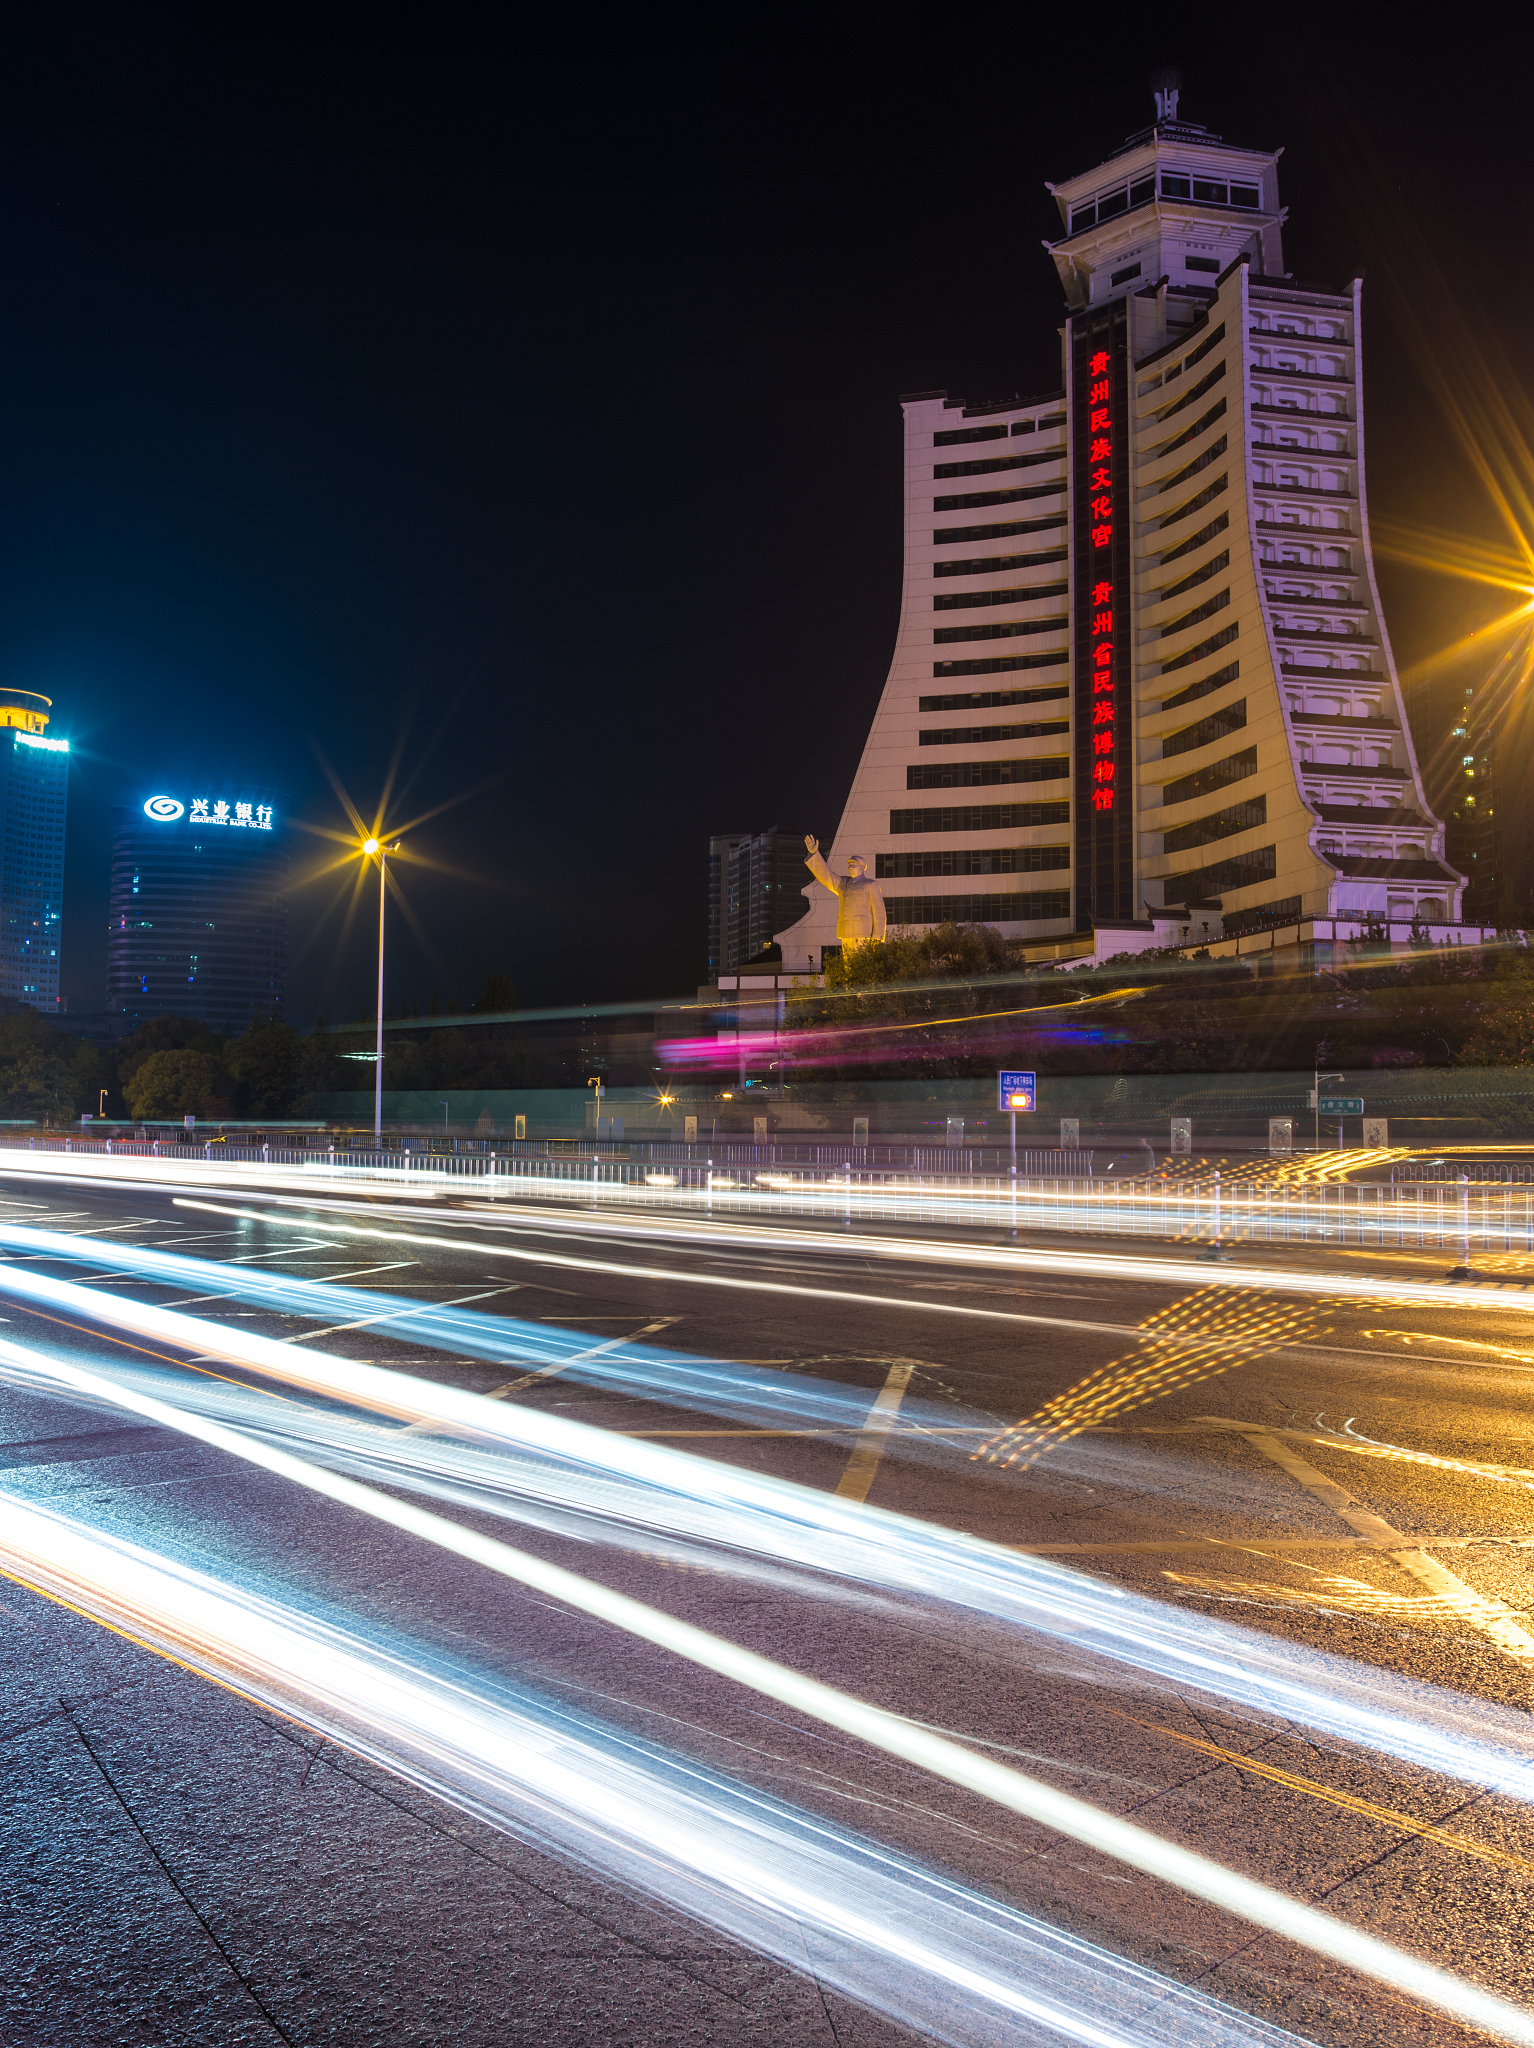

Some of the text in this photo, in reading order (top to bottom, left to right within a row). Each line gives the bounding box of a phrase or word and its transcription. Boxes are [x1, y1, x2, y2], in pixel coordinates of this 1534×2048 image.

[1089, 352, 1112, 547] 贵州民族文化宫
[1092, 582, 1115, 810] 贵州省民族博物馆
[190, 799, 272, 822] 兴业银行
[190, 816, 228, 825] INDUSTRIAL
[230, 819, 247, 827] BANK
